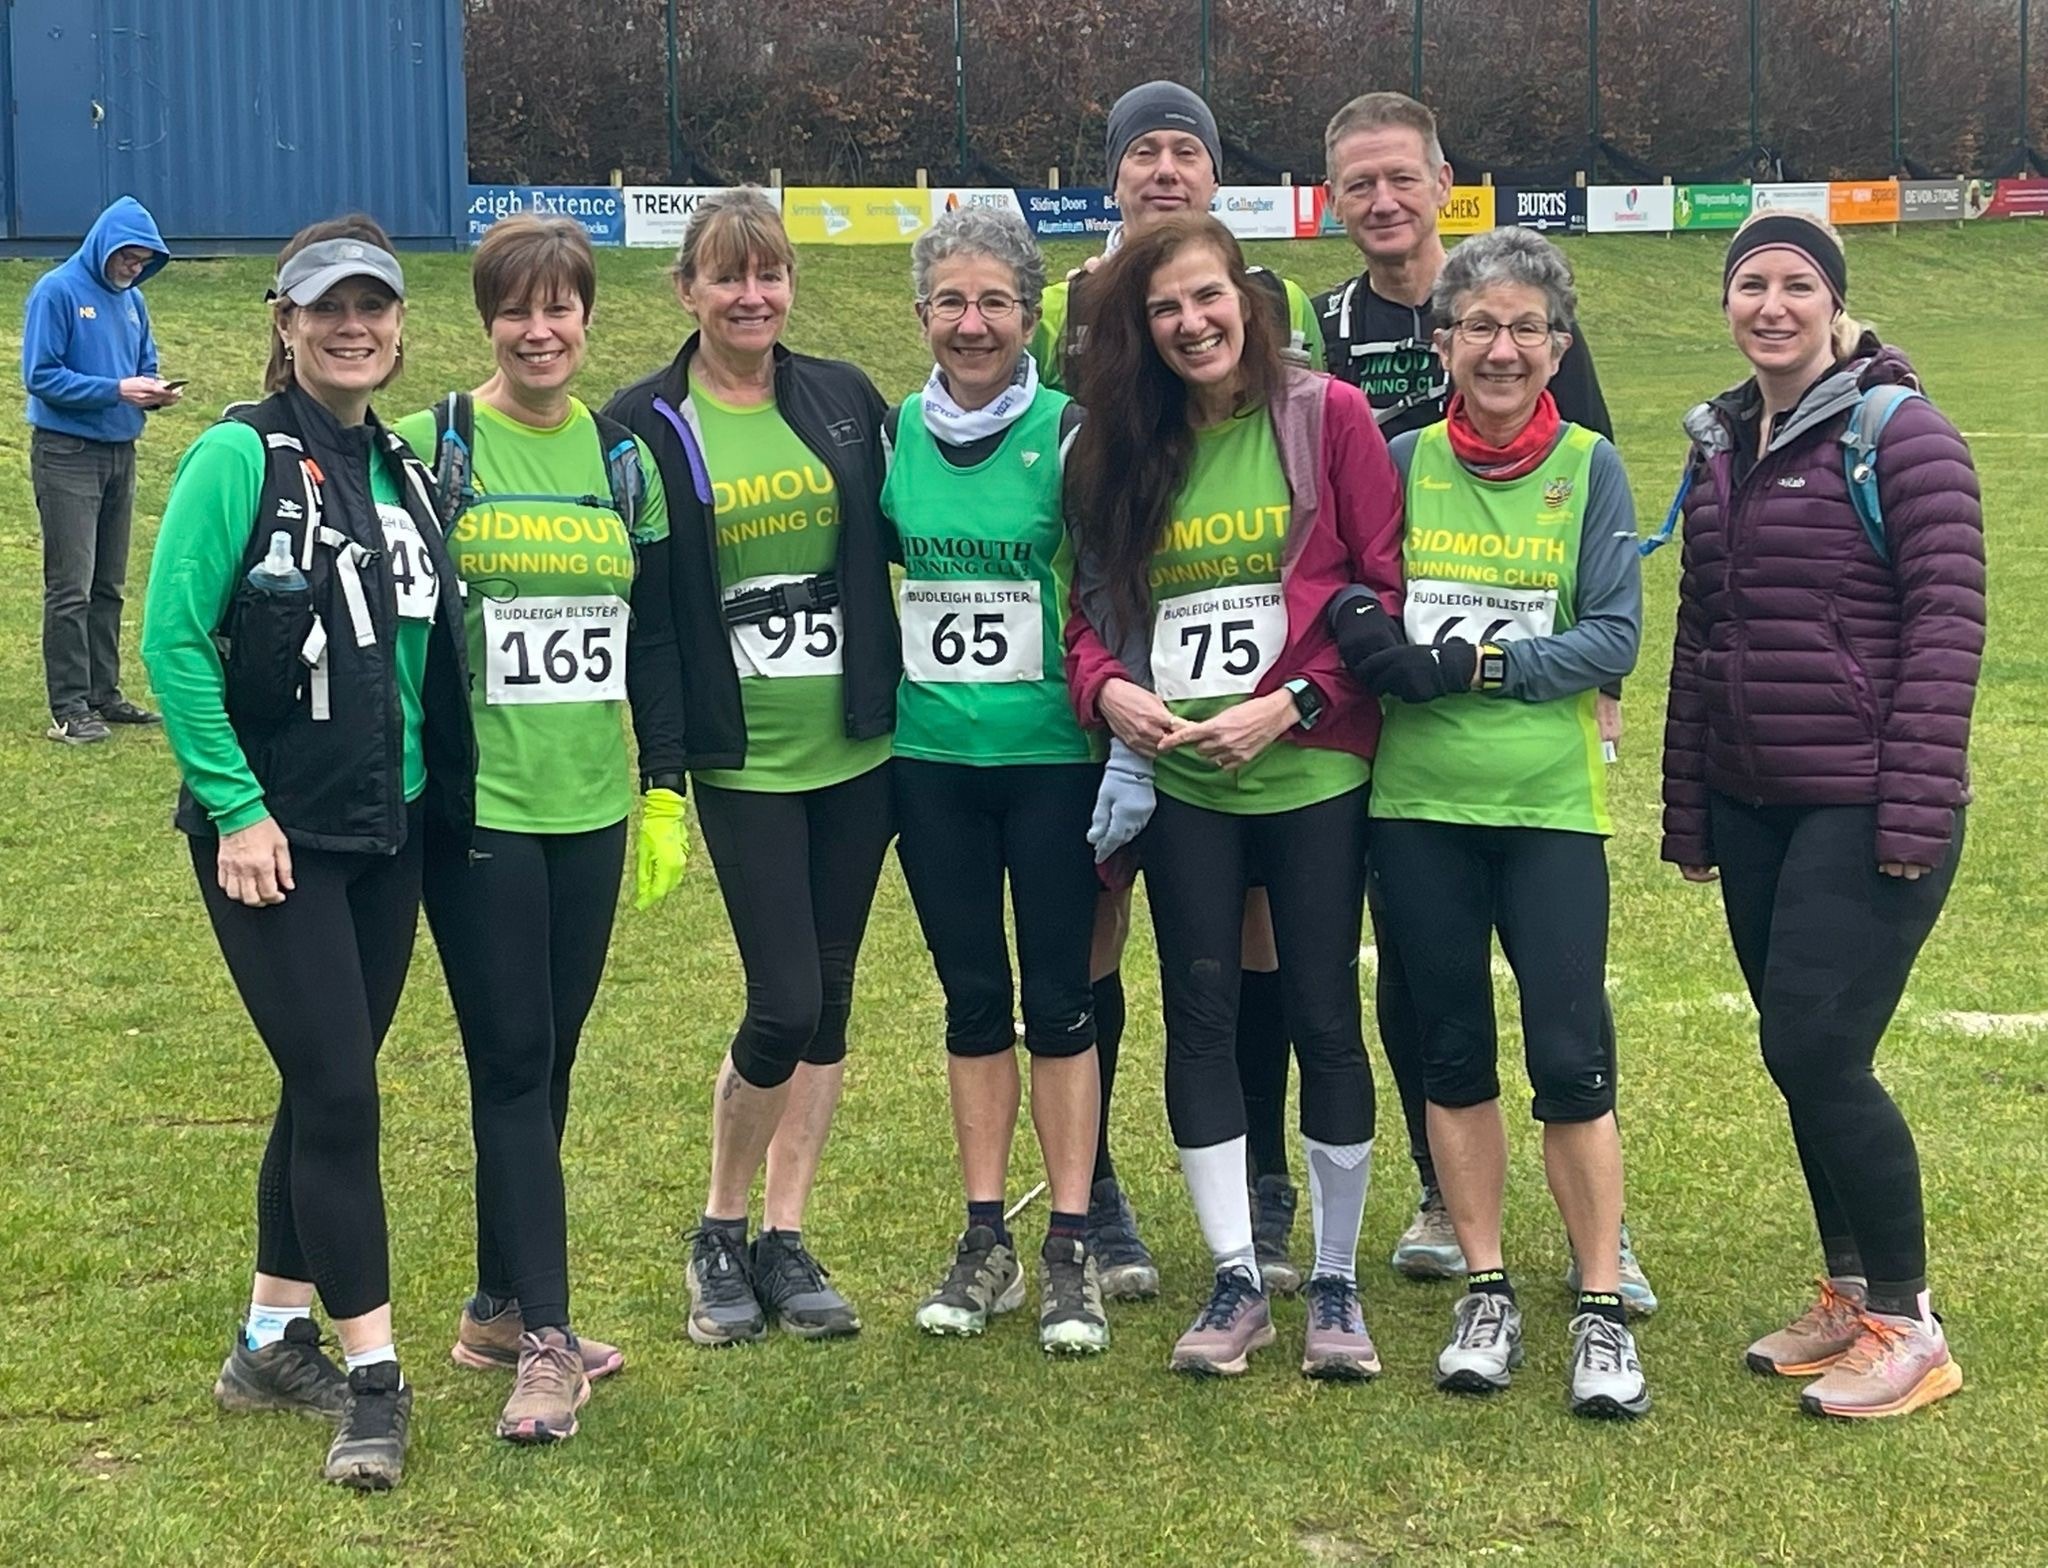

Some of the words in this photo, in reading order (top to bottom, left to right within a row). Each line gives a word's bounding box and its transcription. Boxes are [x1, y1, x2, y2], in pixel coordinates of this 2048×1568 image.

[532, 191, 616, 216] Extence
[1030, 196, 1060, 215] Sliding
[1061, 196, 1087, 211] Doors
[1517, 191, 1567, 216] BURTS
[1411, 527, 1565, 564] SIDMOUTH
[460, 553, 588, 575] RUNNING
[1408, 560, 1498, 583] RUNNING
[1504, 568, 1559, 588] CLUB
[907, 591, 971, 604] BUDLEIGH
[975, 591, 1032, 604] BLISTER
[1163, 600, 1219, 621] BUDLEIGH
[1222, 594, 1281, 611] BLISTER
[1414, 591, 1483, 607] BUDLEIGH
[1486, 597, 1545, 612] BLISTER
[494, 608, 562, 621] BUDLEIGH
[566, 606, 618, 619] BLISTER
[932, 612, 1008, 666] 65
[1180, 619, 1260, 680] 75
[500, 628, 612, 685] 165
